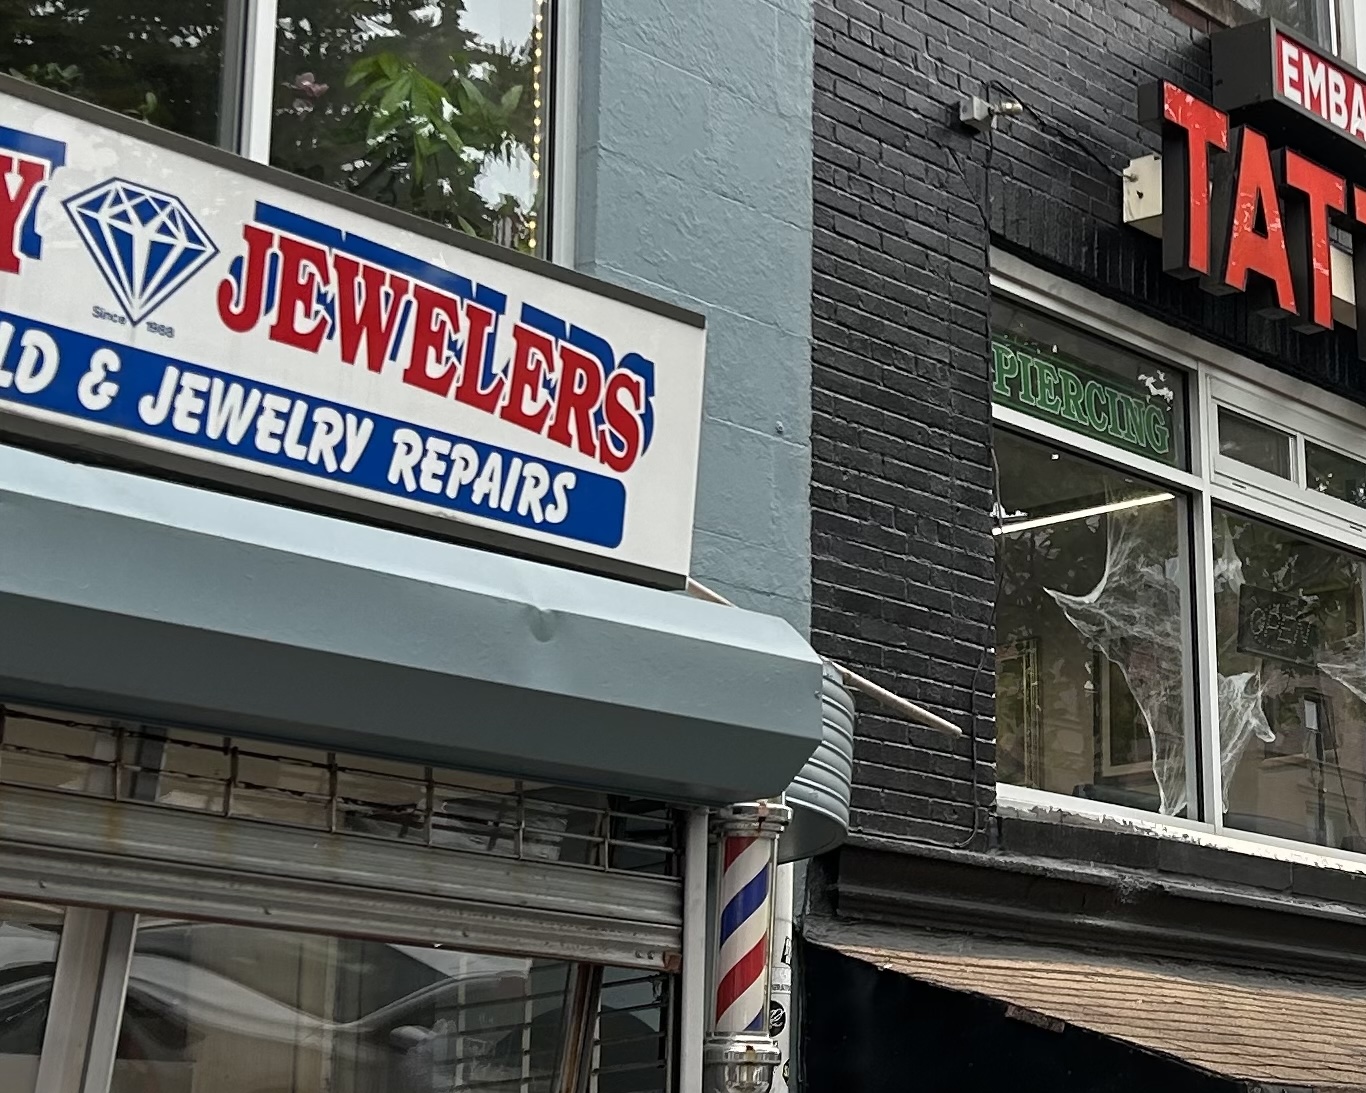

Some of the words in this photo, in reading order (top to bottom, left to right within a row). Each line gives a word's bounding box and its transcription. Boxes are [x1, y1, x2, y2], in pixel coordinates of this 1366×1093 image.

[92, 305, 127, 325] Since
[216, 222, 650, 473] JEWELERS
[77, 347, 121, 411] &
[138, 365, 374, 474] JEWELRY
[388, 427, 578, 525] REPAIRS
[990, 342, 1172, 457] PIERCING
